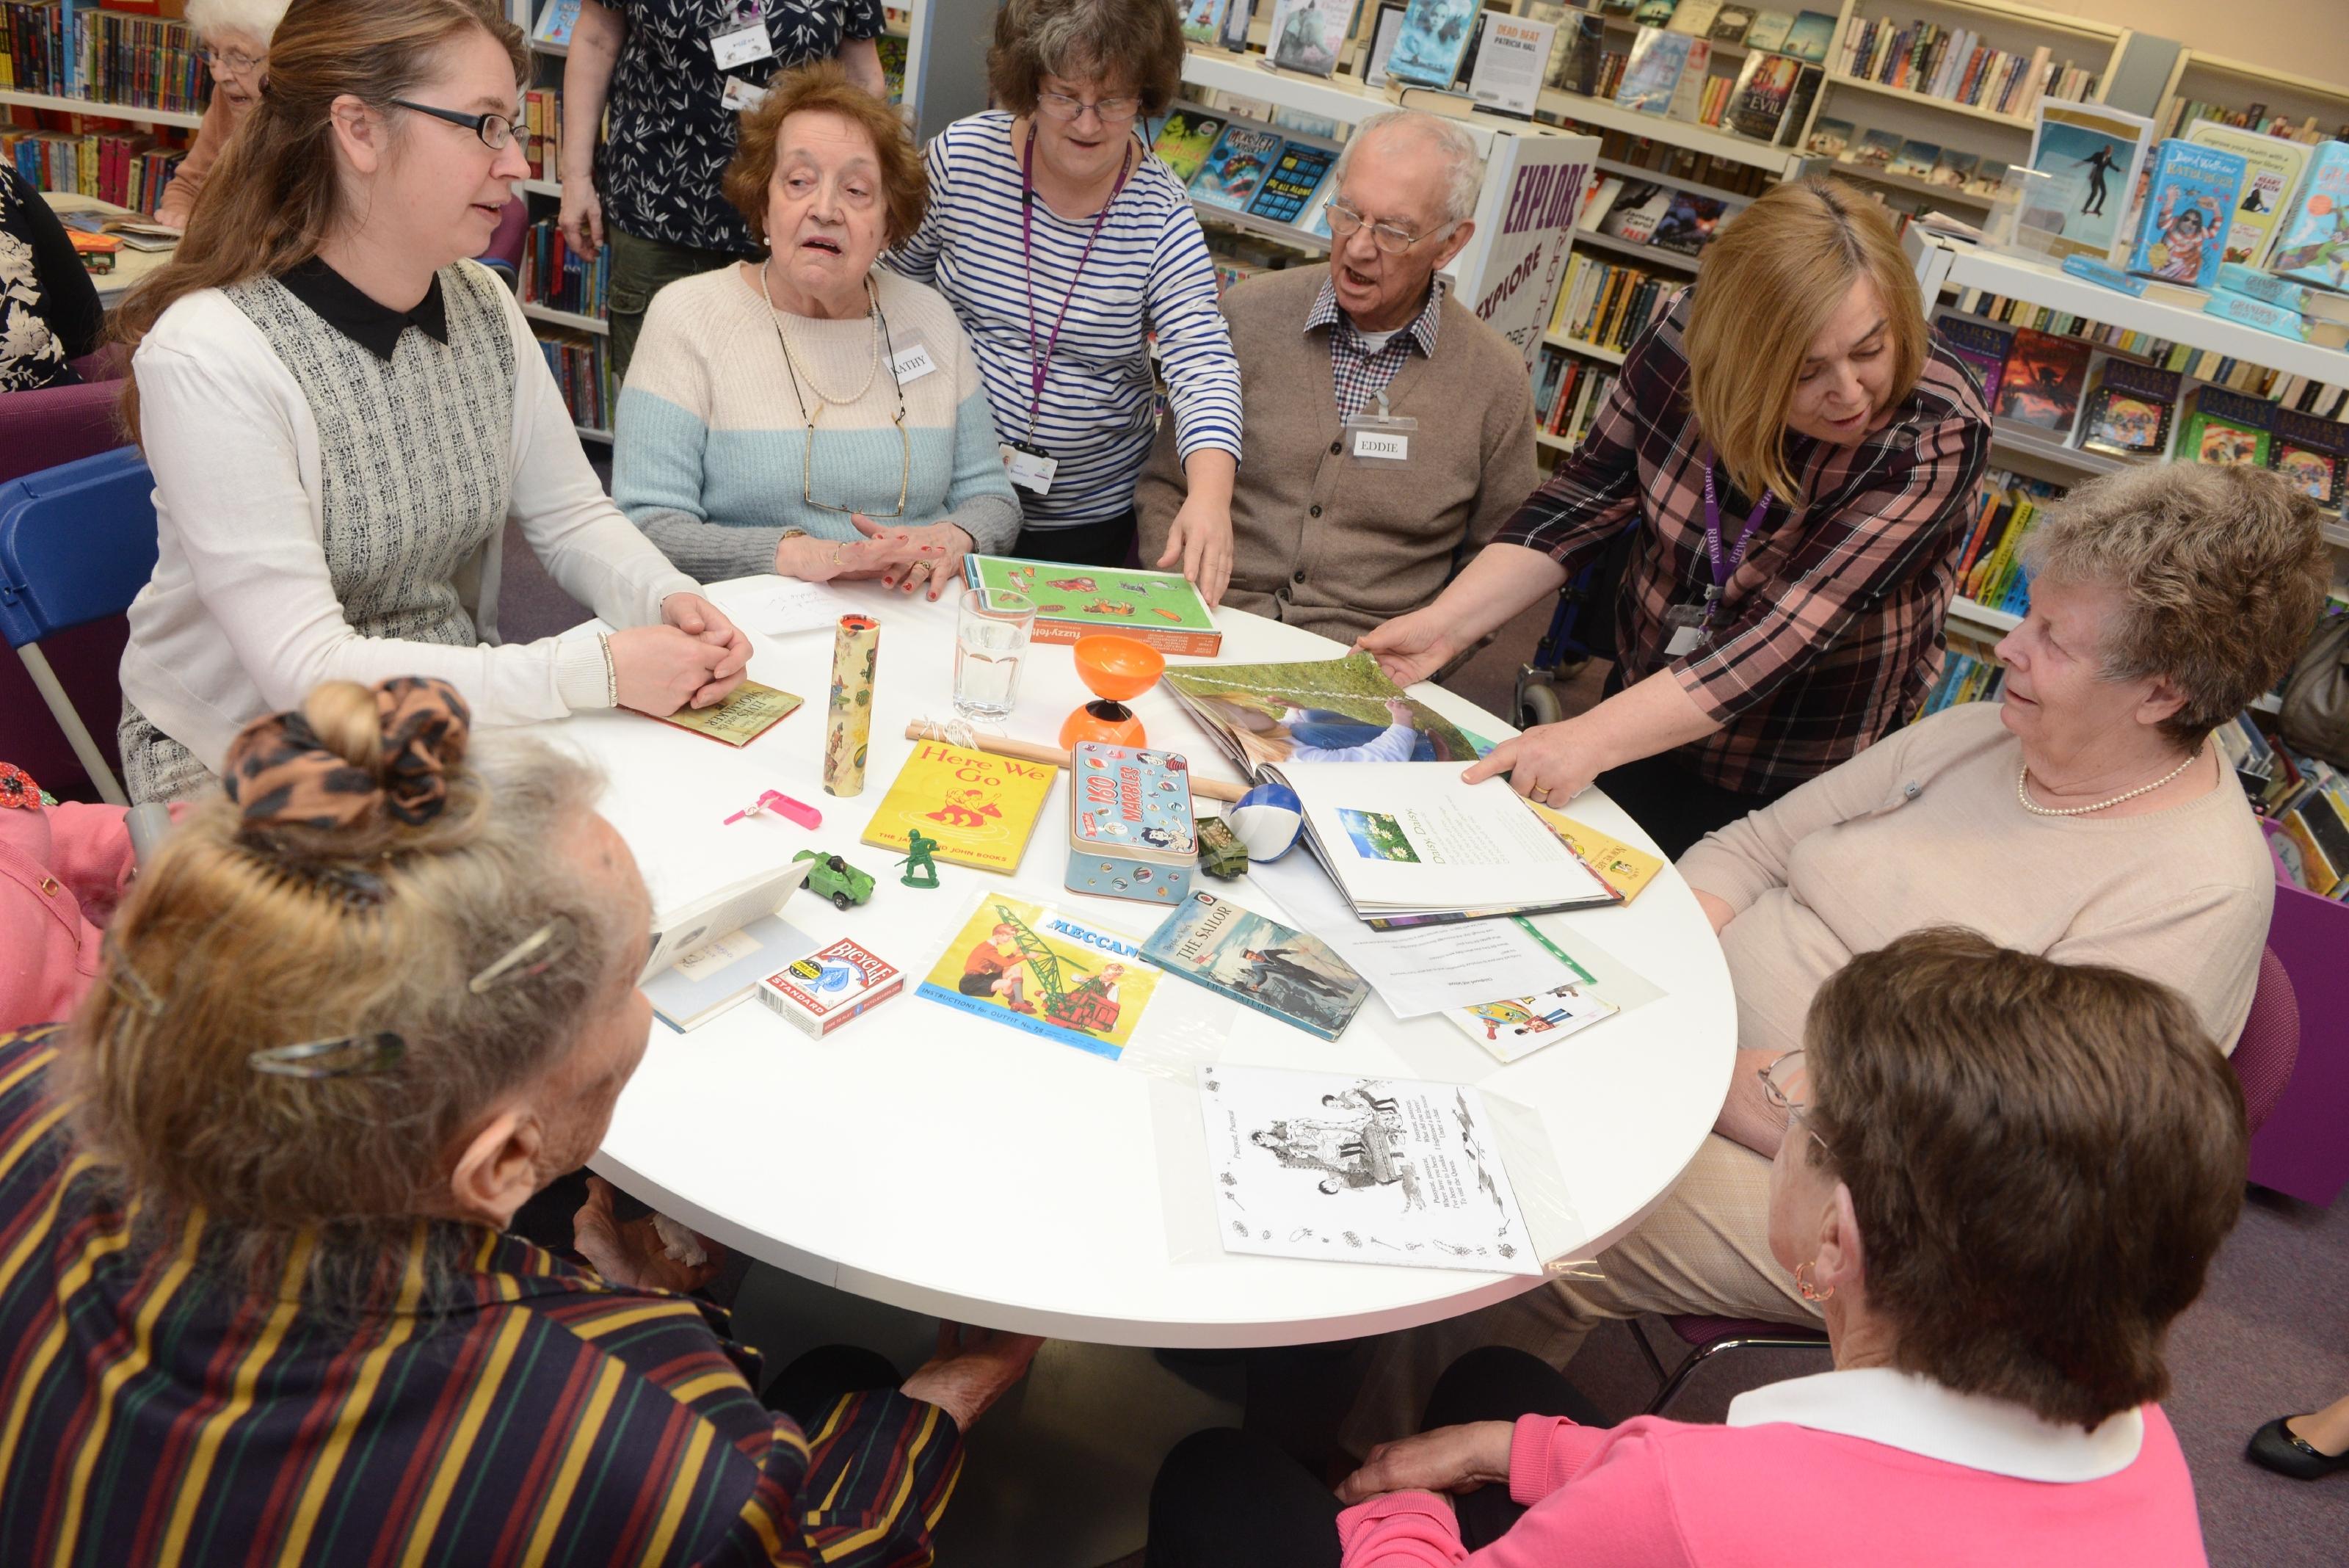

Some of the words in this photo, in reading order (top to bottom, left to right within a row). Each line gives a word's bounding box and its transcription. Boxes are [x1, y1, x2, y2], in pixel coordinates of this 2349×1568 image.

[1497, 23, 1517, 37] DEAD
[1520, 29, 1540, 42] BEAT
[1494, 37, 1521, 48] PATRICIA
[1522, 43, 1536, 52] HALL
[1749, 96, 1781, 115] EVIL
[1228, 129, 1275, 152] MONSTER
[2247, 146, 2268, 158] health
[2262, 161, 2285, 171] library
[1277, 183, 1290, 192] ALL
[1290, 185, 1313, 197] ALONE
[2254, 181, 2280, 192] HEALTH
[2257, 176, 2282, 186] HEART
[1503, 164, 1589, 234] EXPLORE
[1624, 208, 1655, 222] James
[1626, 217, 1654, 229] Carol
[1621, 227, 1649, 242] PREY
[1475, 242, 1542, 321] EXPLORE
[1946, 319, 2000, 341] HARRY
[890, 355, 925, 374] KATHY
[2113, 360, 2172, 383] HARRY
[2110, 369, 2173, 394] POTTER
[2206, 390, 2263, 411] HARRY
[2204, 399, 2268, 424] POTTER
[2281, 411, 2343, 435] HARRY
[2281, 421, 2345, 447] POTTER
[1361, 440, 1398, 453] EDDIE
[1704, 466, 1713, 504] RBWM
[1760, 487, 1773, 509] RB
[1707, 528, 1720, 565] RBWM
[1729, 529, 1754, 564] RBWM
[705, 690, 763, 726] SHOEMAKER
[737, 701, 766, 719] ELVES
[729, 716, 739, 725] and
[919, 746, 992, 769] Here
[1004, 761, 1045, 780] We
[955, 768, 1001, 786] Go
[1086, 775, 1118, 805] 160
[1119, 766, 1144, 823] MARBLES
[951, 846, 973, 856] JOHN
[976, 852, 1007, 862] BOOKS
[1595, 860, 1608, 871] ARE
[1047, 919, 1139, 959] MECCAN
[1176, 939, 1203, 961] THE
[1195, 906, 1232, 940] SAILOR
[1163, 936, 1180, 954] People
[796, 961, 810, 973] FREE
[808, 968, 819, 977] APP
[821, 942, 893, 987] BICYCLE
[771, 977, 824, 1014] STANDARD
[1205, 981, 1224, 993] THE
[1232, 992, 1271, 1014] SAILOR
[921, 987, 976, 1009] INSTRUCTIONS
[991, 1011, 1018, 1023] OUTFIT
[1021, 1020, 1031, 1029] No.
[1413, 1100, 1423, 1113] there?
[1228, 1110, 1237, 1133] Pussycat
[1421, 1132, 1429, 1142] What
[1428, 1124, 1441, 1146] frightened
[1436, 1125, 1445, 1138] Under
[1430, 1154, 1439, 1168] been?
[1438, 1155, 1448, 1172] London
[1448, 1159, 1459, 1177] Queen.
[1437, 1180, 1446, 1190] have
[1448, 1187, 1456, 1198] been
[1456, 1187, 1464, 1197] visit
[1439, 1191, 1450, 1208] Where
[1451, 1199, 1459, 1208] I've
